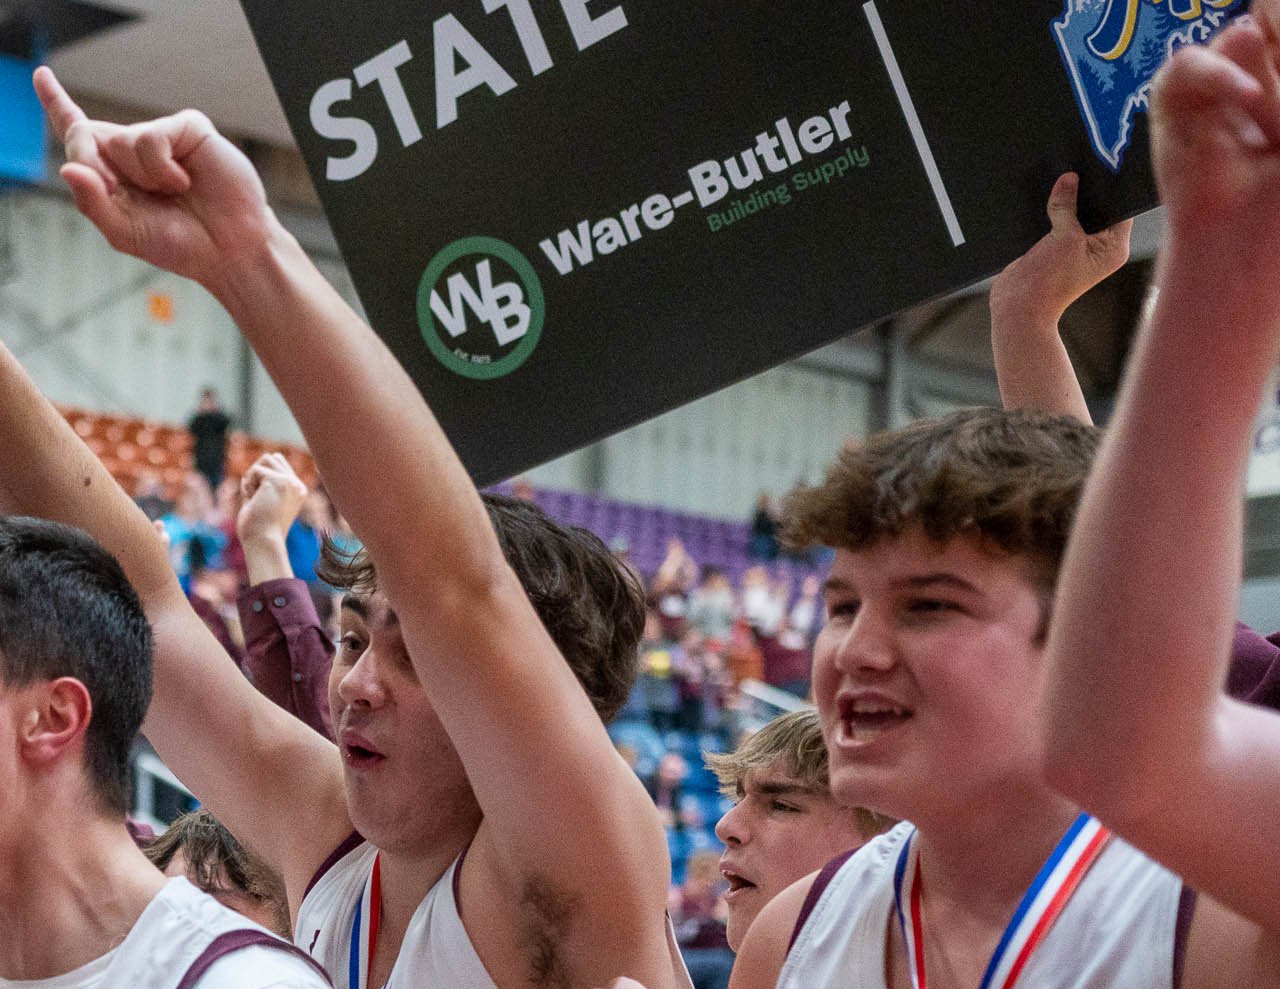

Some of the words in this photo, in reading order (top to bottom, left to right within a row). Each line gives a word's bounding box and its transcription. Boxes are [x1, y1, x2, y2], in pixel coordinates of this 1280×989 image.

[309, 0, 629, 181] STATE
[538, 100, 853, 276] Ware-Butler
[706, 184, 793, 233] Building
[792, 146, 870, 191] Supply
[429, 258, 531, 347] WB
